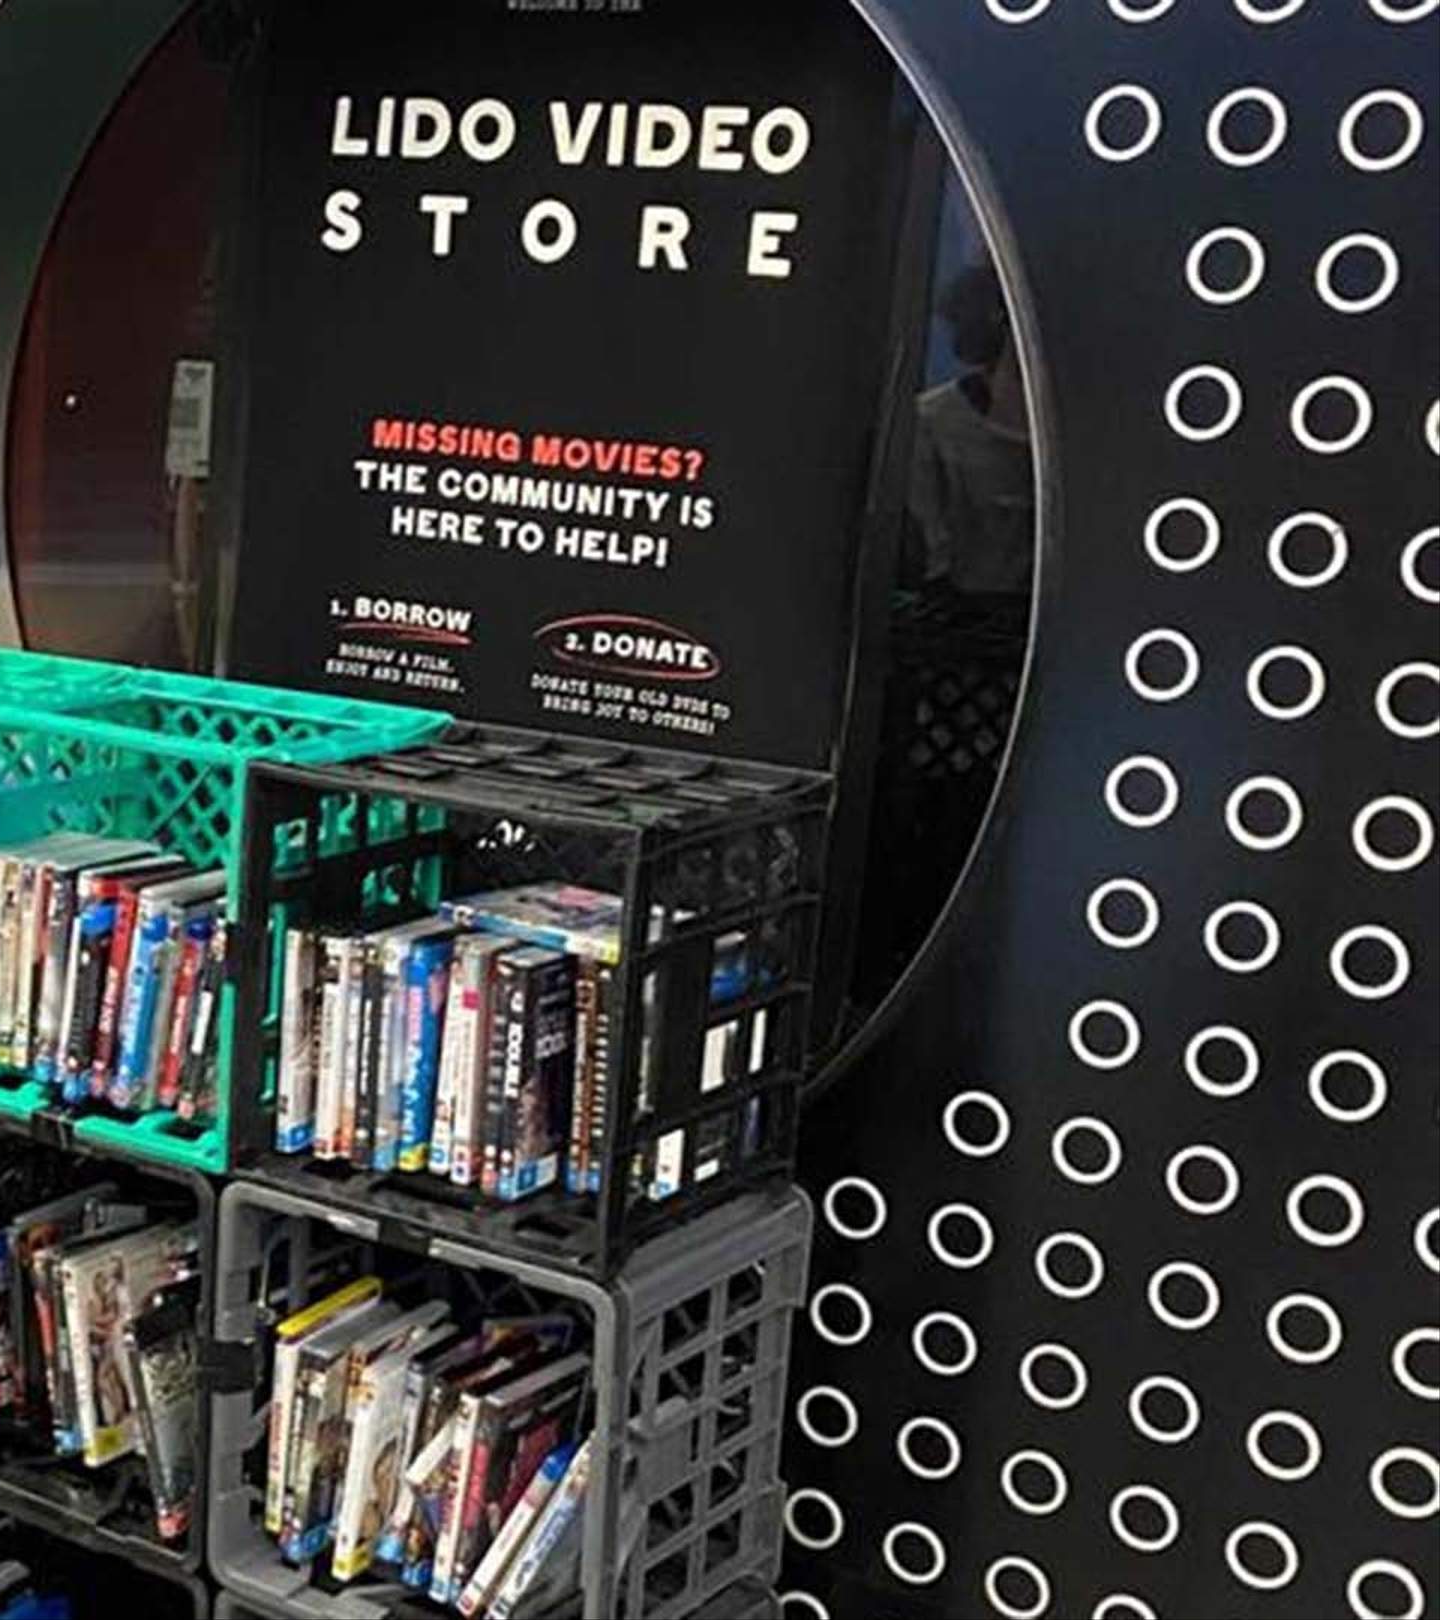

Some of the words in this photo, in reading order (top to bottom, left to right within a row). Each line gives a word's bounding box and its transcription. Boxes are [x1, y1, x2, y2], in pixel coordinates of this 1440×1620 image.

[331, 97, 515, 161] LIDO
[549, 102, 810, 174] VIDEO
[373, 420, 522, 462] MISSING
[532, 435, 705, 481] MOVIES?
[355, 461, 427, 493] THE
[439, 469, 669, 522] COMMUNITY
[680, 497, 714, 529] IS
[391, 507, 484, 545] HERE
[494, 520, 544, 552] TO
[555, 528, 669, 567] HELP!
[330, 600, 348, 616] 1.
[354, 597, 472, 632] BORROW
[338, 643, 395, 663] BORROW
[398, 652, 409, 667] A
[565, 633, 585, 651] 2.
[592, 631, 711, 668] DONATE
[372, 666, 401, 682] AND
[530, 673, 588, 695] DONATE
[593, 683, 634, 701] YOUR
[638, 689, 668, 706] OLD
[713, 703, 731, 721] TO
[594, 703, 625, 720] JOY
[628, 707, 650, 723] TO
